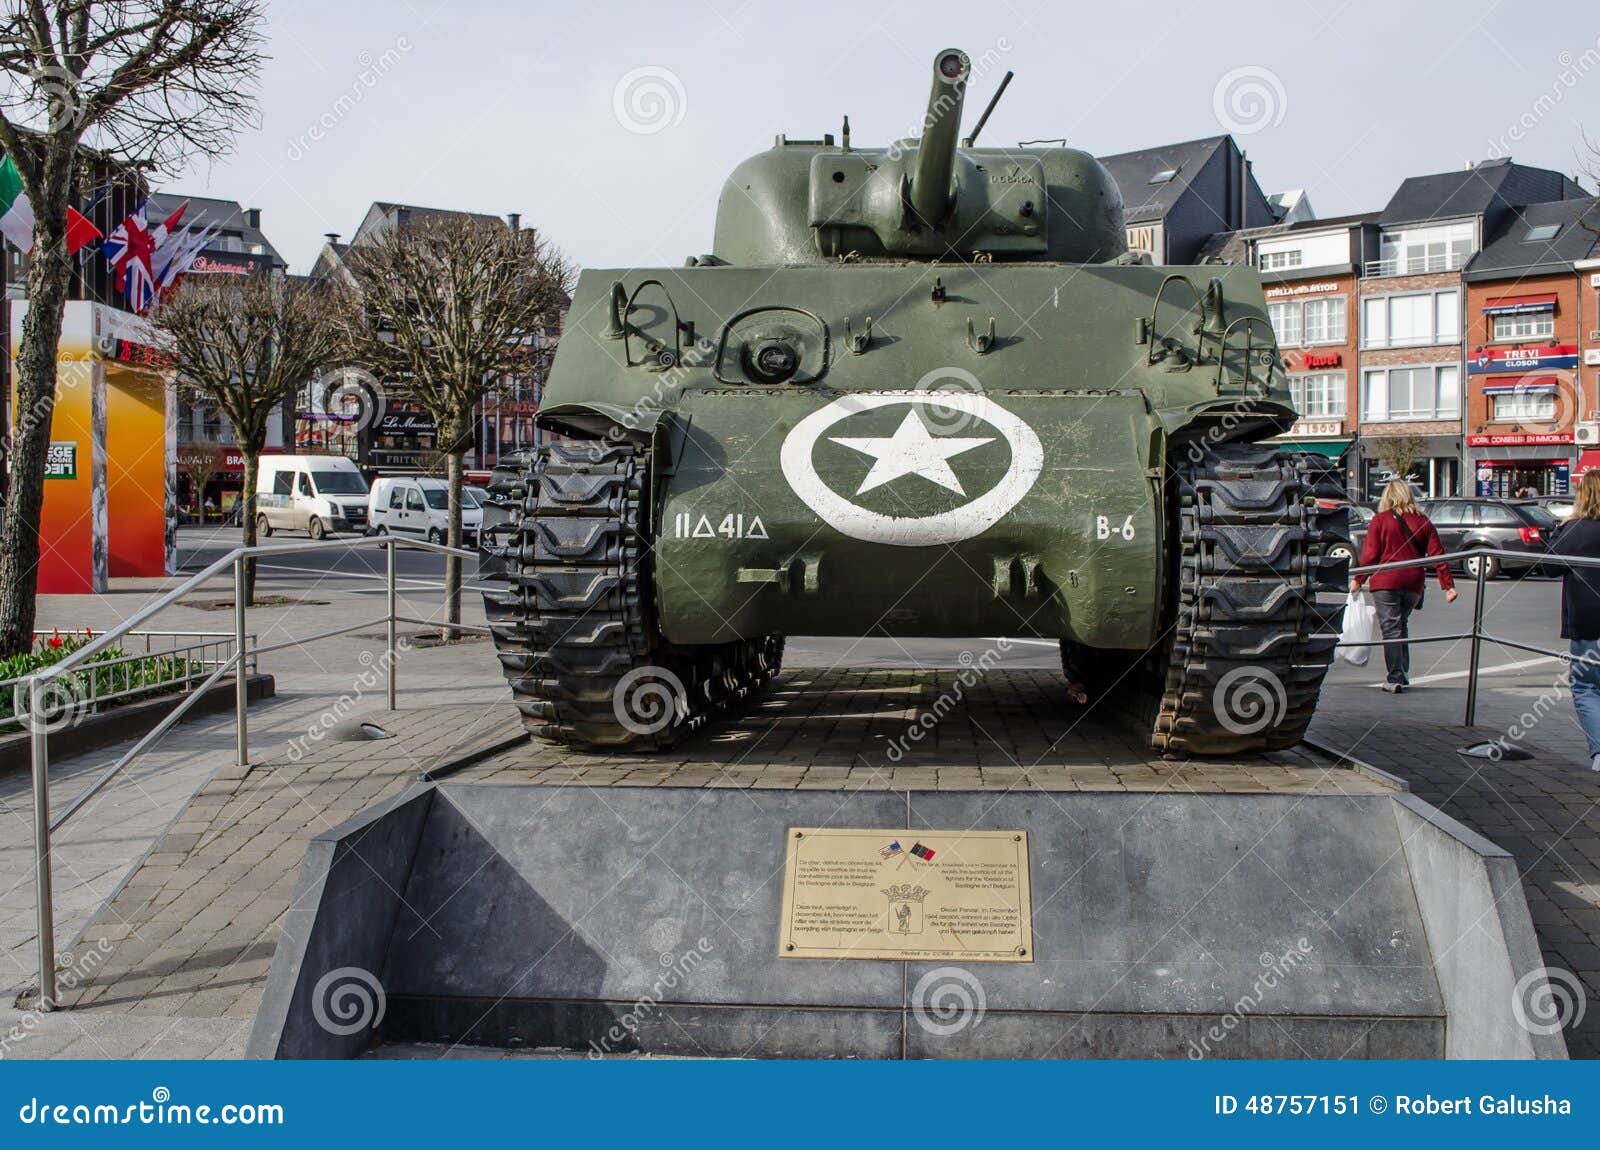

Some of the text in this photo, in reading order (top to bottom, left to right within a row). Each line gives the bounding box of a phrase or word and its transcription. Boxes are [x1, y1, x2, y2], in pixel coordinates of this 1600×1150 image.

[1303, 352, 1339, 369] Duvel
[1504, 349, 1539, 359] TREVI
[1505, 359, 1539, 368] CLOSON
[1096, 514, 1135, 541] B-6
